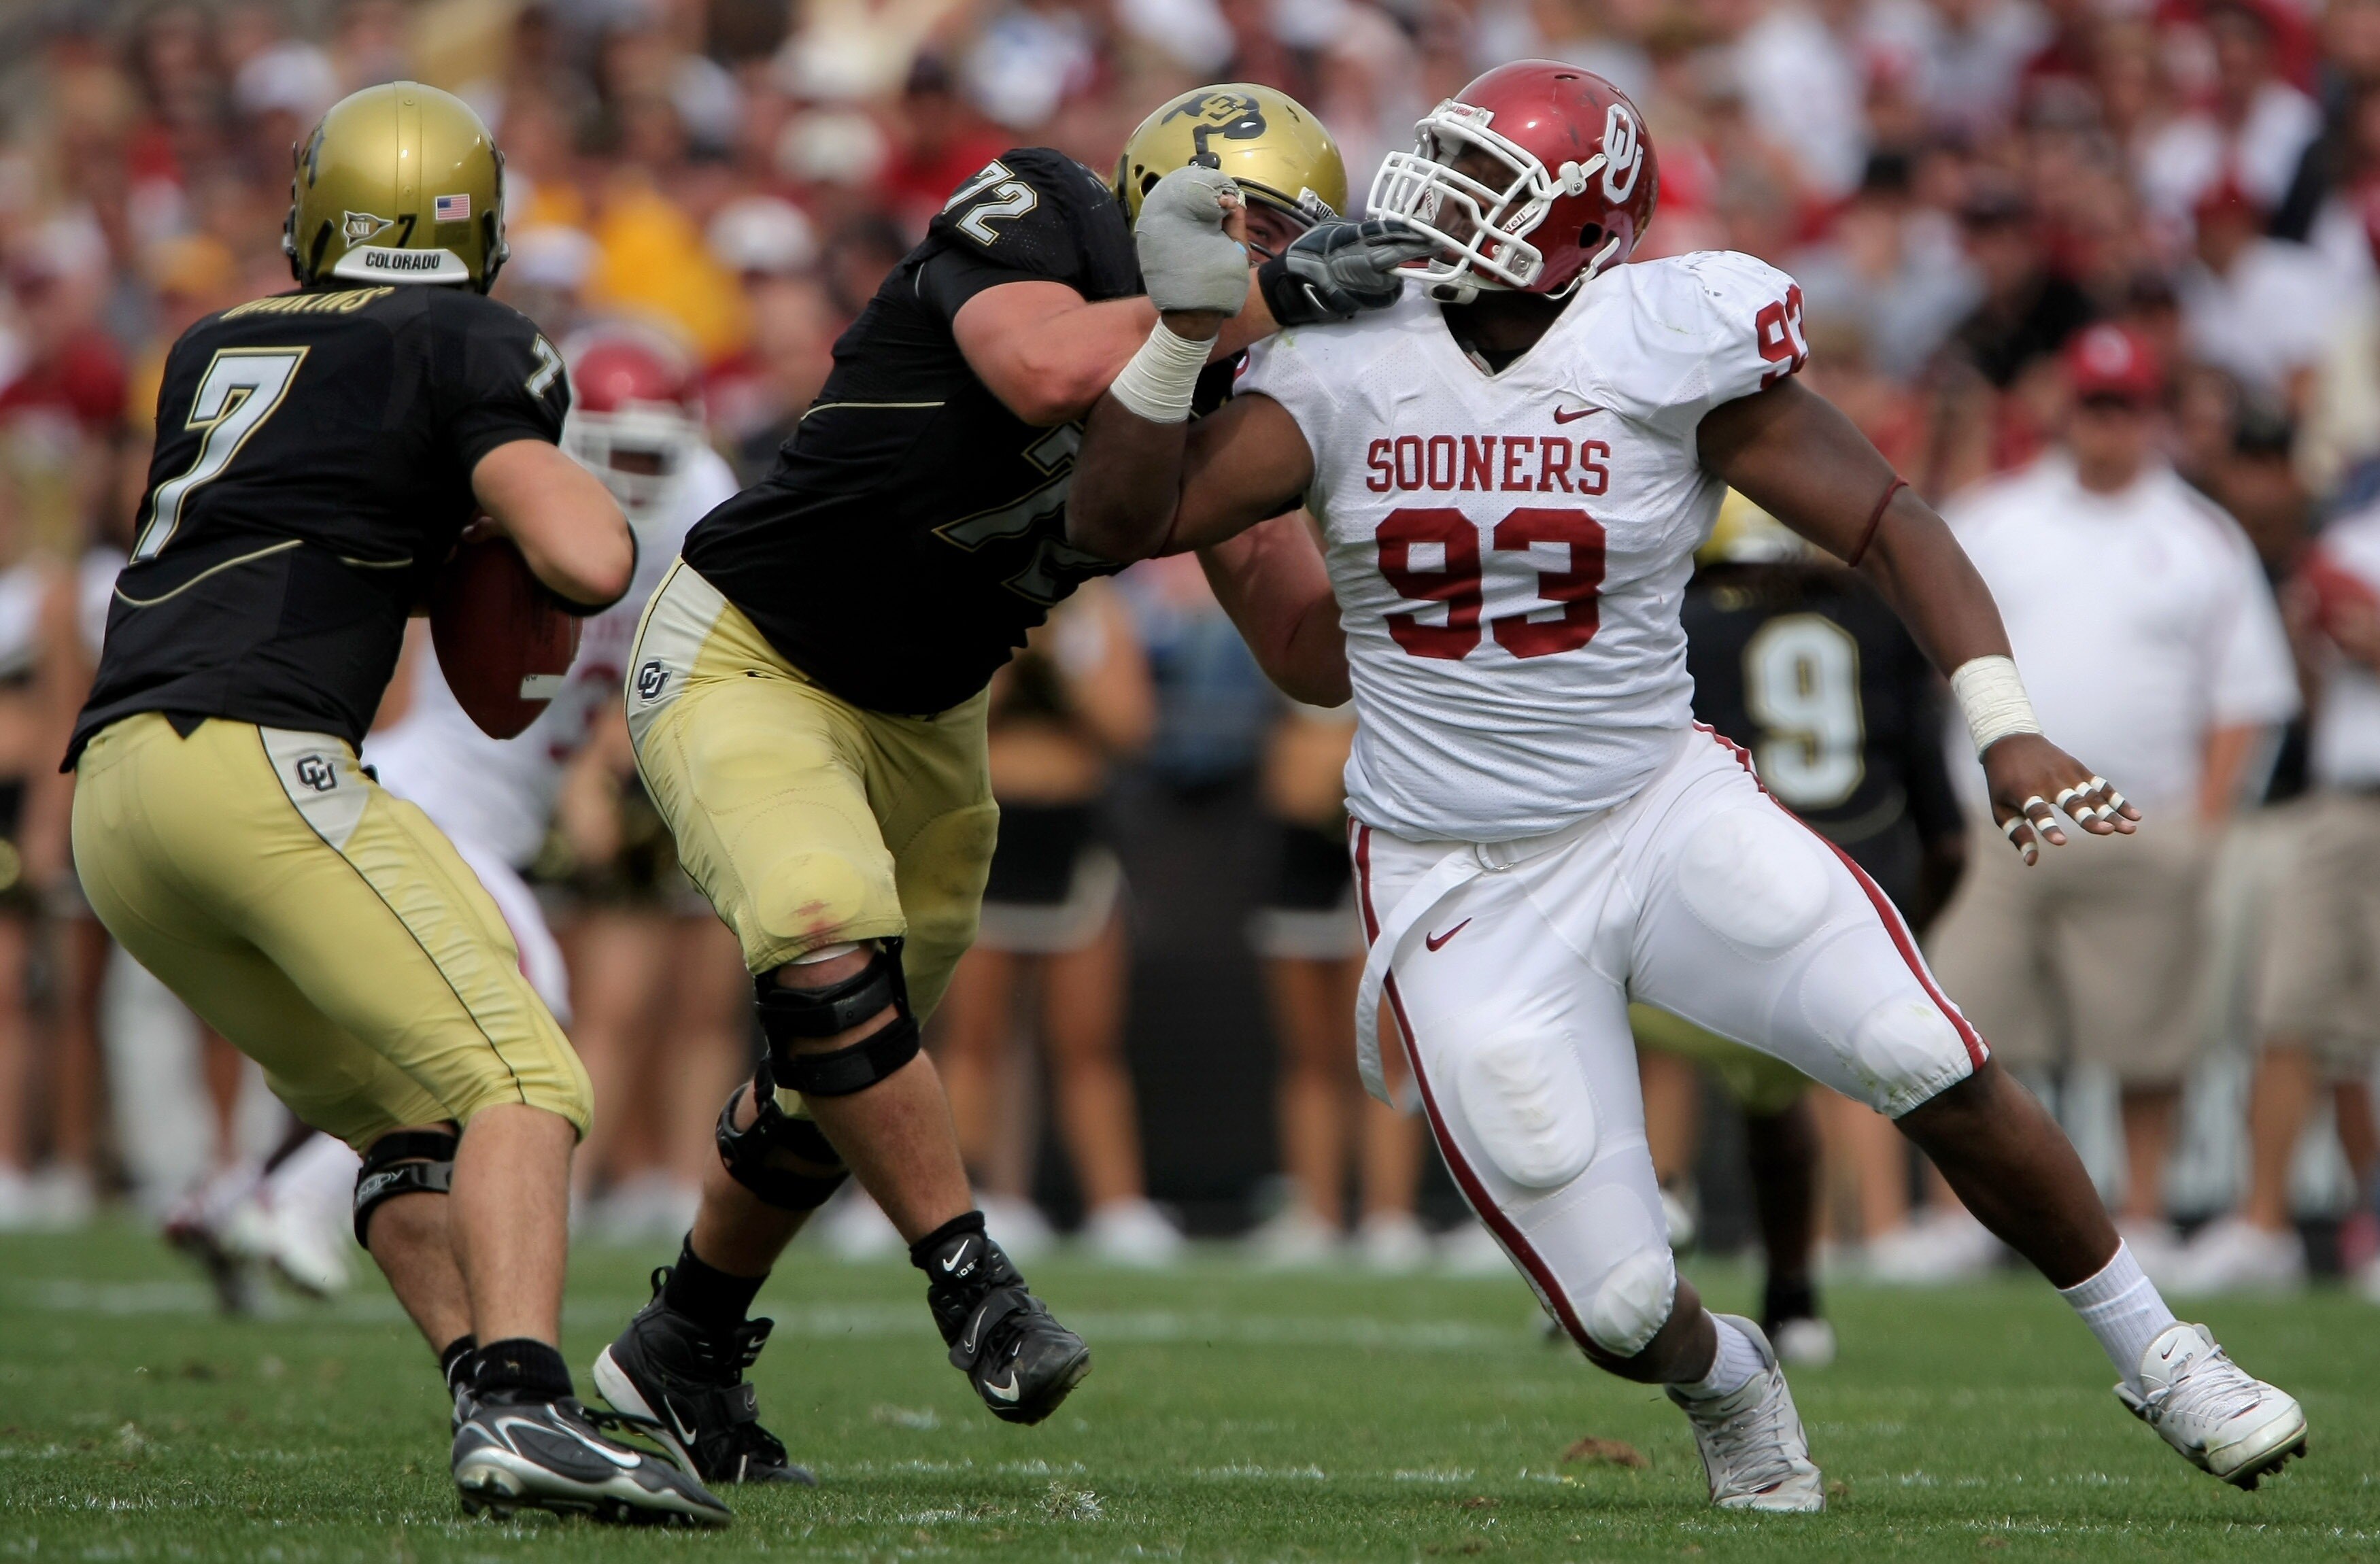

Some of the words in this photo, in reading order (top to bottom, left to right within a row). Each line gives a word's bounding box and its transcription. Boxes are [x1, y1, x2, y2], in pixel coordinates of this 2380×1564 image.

[352, 220, 371, 235] XII
[396, 213, 418, 249] 7
[942, 158, 1038, 246] 72
[365, 251, 442, 271] COLORADO
[524, 333, 565, 400] 7
[129, 345, 311, 565] 7
[1366, 434, 1611, 496] SOONERS
[1375, 507, 1607, 661] 93
[1743, 611, 1866, 811] 9
